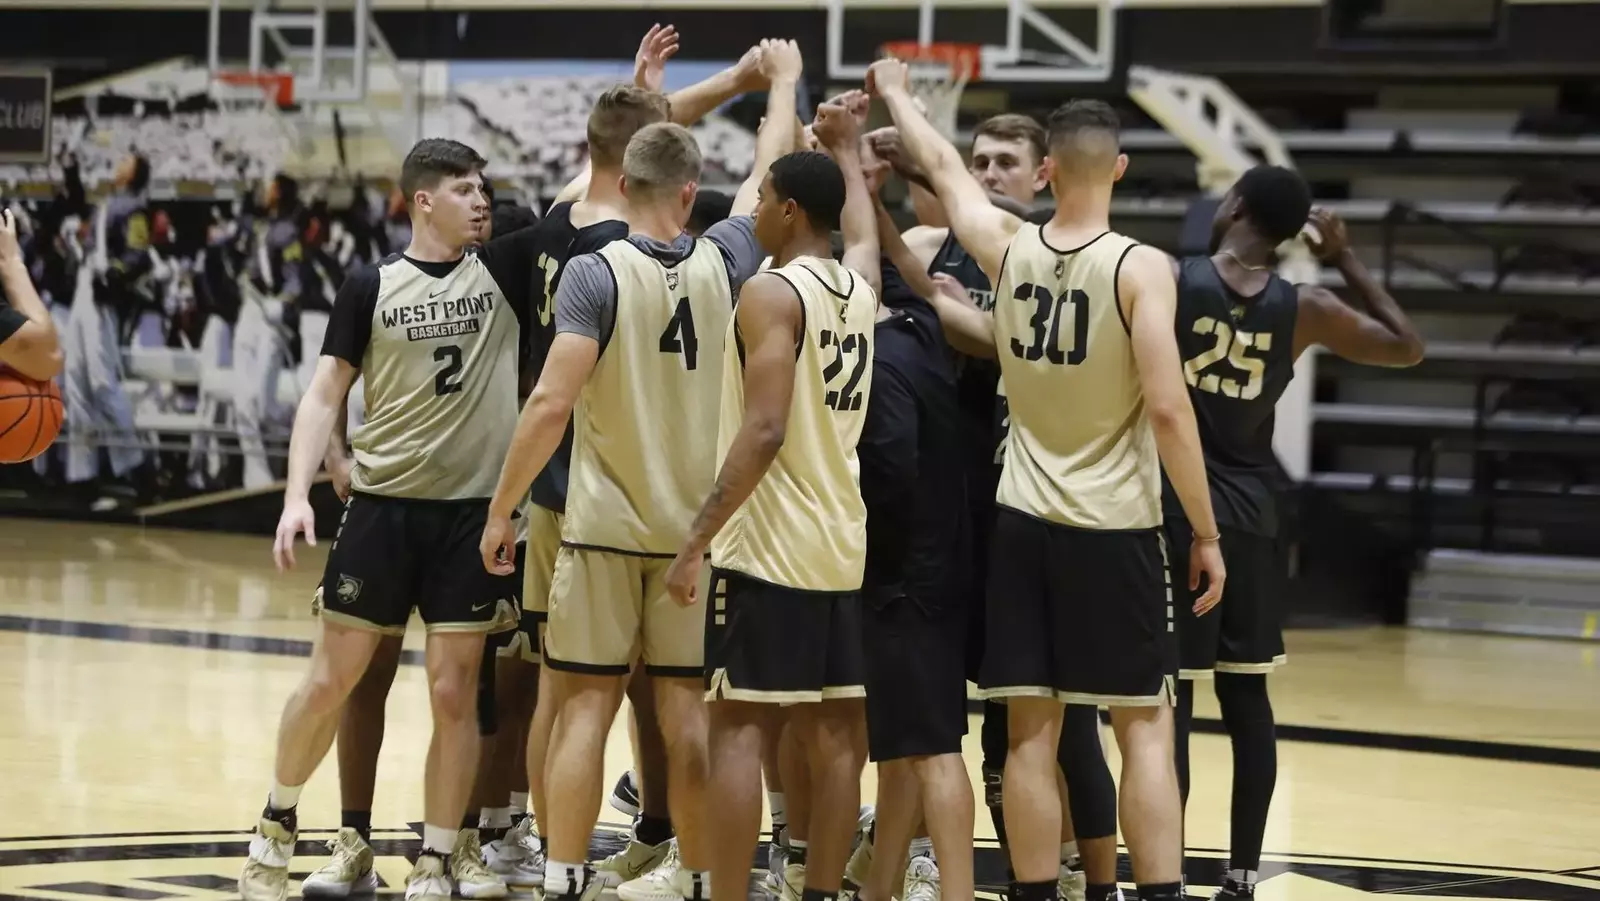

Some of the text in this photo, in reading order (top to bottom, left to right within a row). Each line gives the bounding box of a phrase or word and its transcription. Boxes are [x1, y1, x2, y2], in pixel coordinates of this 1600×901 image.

[382, 292, 494, 328] WEST POINT
[410, 320, 478, 340] BASKETBALL
[659, 296, 698, 371] 4
[1010, 282, 1090, 366] 30
[433, 345, 463, 396] 2
[820, 329, 868, 411] 22
[1184, 316, 1272, 400] 25
